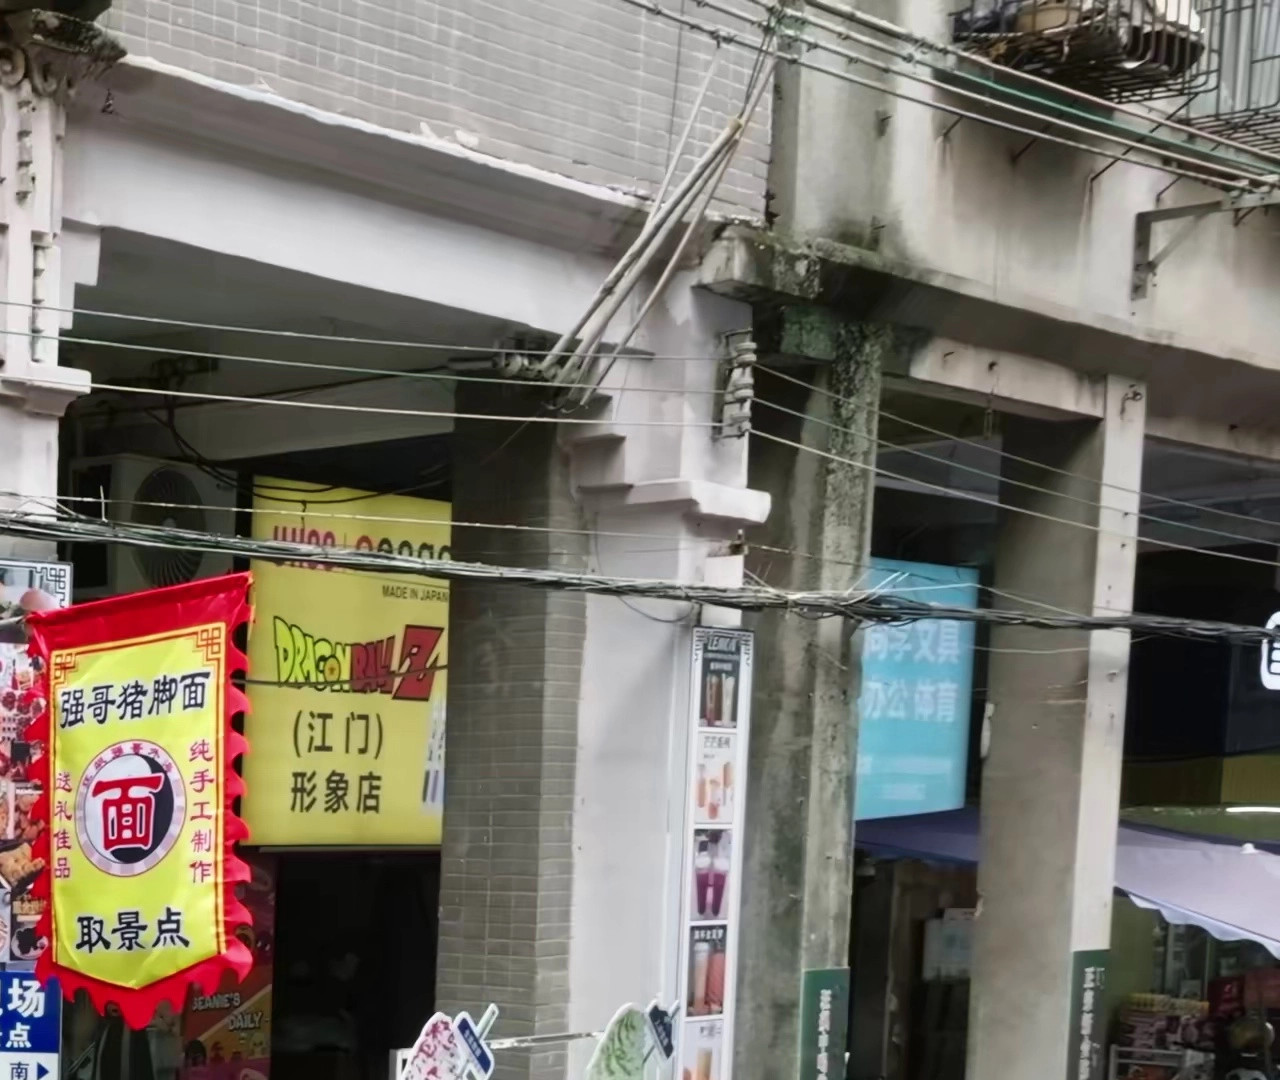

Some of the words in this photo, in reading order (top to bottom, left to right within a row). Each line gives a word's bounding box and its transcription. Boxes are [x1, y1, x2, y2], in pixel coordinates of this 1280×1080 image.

[382, 584, 407, 600] MADE
[409, 587, 419, 601] IN
[420, 588, 449, 603] JAPAN
[59, 671, 211, 730] 强哥猪脚面
[91, 772, 166, 852] 面
[188, 739, 215, 884] 纯手工制作
[289, 770, 383, 815] 形象店
[53, 772, 74, 880] 送礼佳品
[75, 906, 190, 955] 取景点
